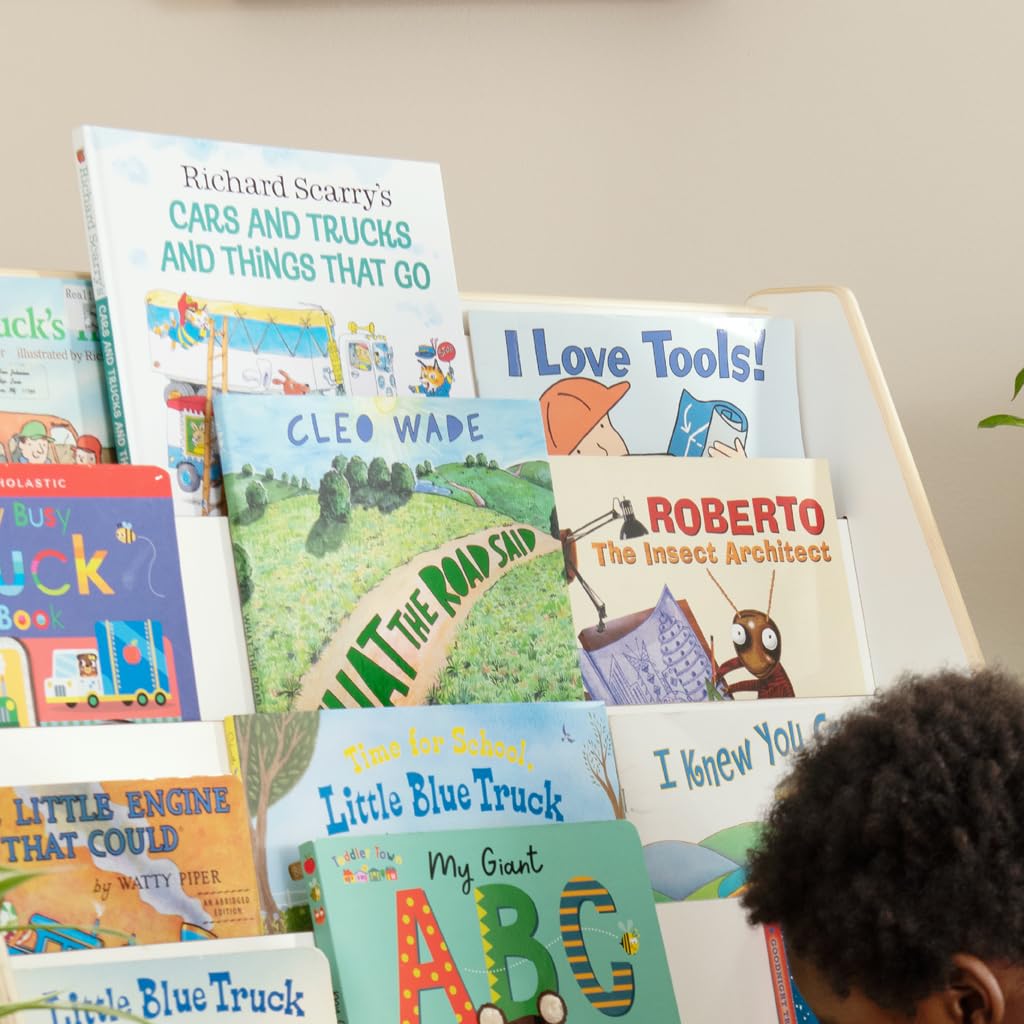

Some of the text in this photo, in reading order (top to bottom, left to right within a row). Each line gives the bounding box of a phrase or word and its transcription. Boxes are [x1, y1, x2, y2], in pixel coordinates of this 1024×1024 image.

[181, 165, 392, 212] Richard Scarry's
[169, 200, 412, 249] CARS AND TRUCKS
[161, 240, 215, 273] AND
[320, 253, 385, 288] THAT
[394, 260, 431, 290] GO
[99, 304, 110, 338] CARS
[17, 347, 68, 361] illustrated
[70, 349, 82, 364] by
[103, 340, 115, 366] AND
[504, 328, 766, 382] I Love Tools!
[108, 367, 122, 419] TRUCKS
[113, 420, 126, 447] AND
[287, 411, 484, 446] CLEO WADE
[646, 496, 825, 537] ROBERTO
[591, 539, 833, 567] The Insect Architect
[386, 588, 439, 650] THE
[418, 544, 491, 618] ROAD
[488, 527, 536, 569] SAID
[344, 726, 534, 774] Time for School,
[653, 747, 677, 790] I
[680, 738, 753, 790] Knew
[753, 719, 805, 766] You
[13, 786, 231, 826] LITTLE ENGINE
[318, 767, 564, 836] Little Blue Truck
[1, 825, 180, 863] THAT COULD
[93, 868, 222, 901] by WATTY PIPER
[428, 844, 544, 895] My Giant
[137, 977, 207, 1020] Blue
[208, 971, 305, 1017] Truck
[770, 938, 788, 1006] GOODNIGHT
